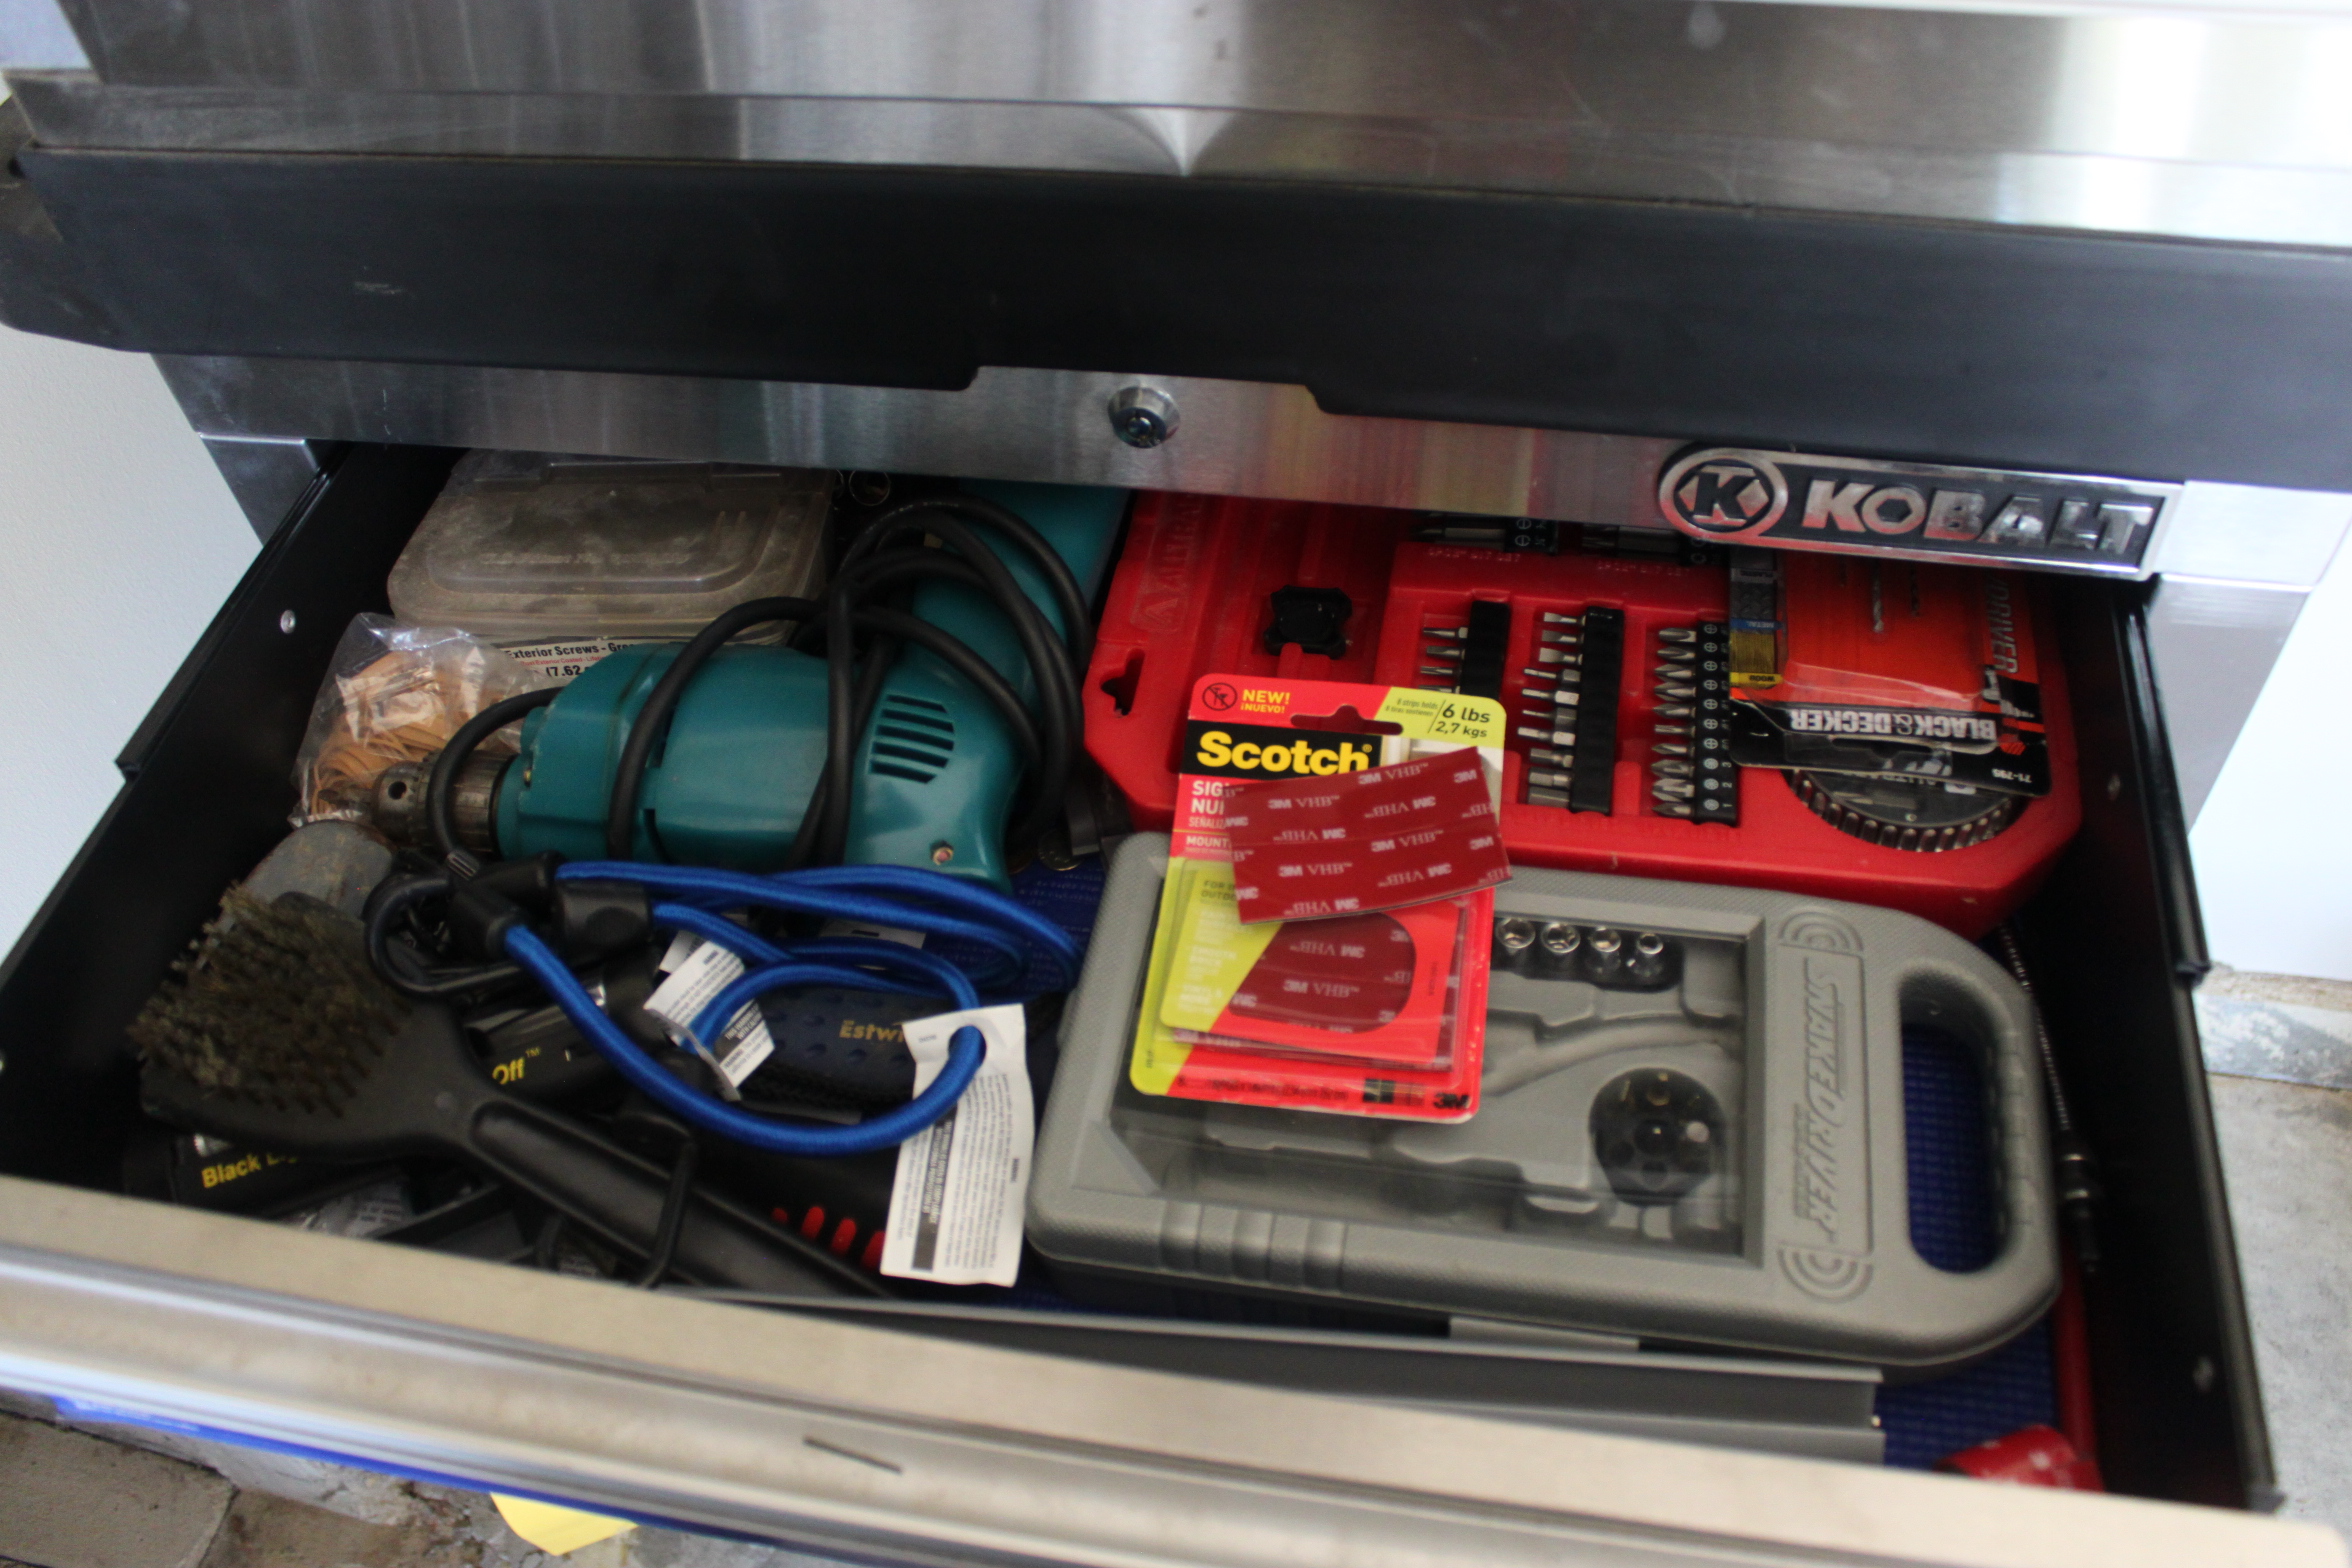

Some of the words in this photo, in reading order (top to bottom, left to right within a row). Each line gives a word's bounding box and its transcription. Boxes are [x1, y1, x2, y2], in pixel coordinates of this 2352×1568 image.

[1802, 479, 2153, 555] KOBALT
[554, 644, 599, 656] Screws
[608, 641, 634, 653] Gre
[1242, 689, 1291, 705] NEW!
[1240, 702, 1286, 713] ¡NUEVO!
[1442, 703, 1456, 718] 6
[1461, 707, 1491, 723] lbs
[1435, 721, 1460, 735] 2,7
[1462, 725, 1488, 739] kgs
[1789, 708, 1998, 741] BLACK&DECKER
[1192, 779, 1230, 797] SIG
[1433, 1091, 1472, 1110] 3M
[201, 1153, 262, 1188] Black
